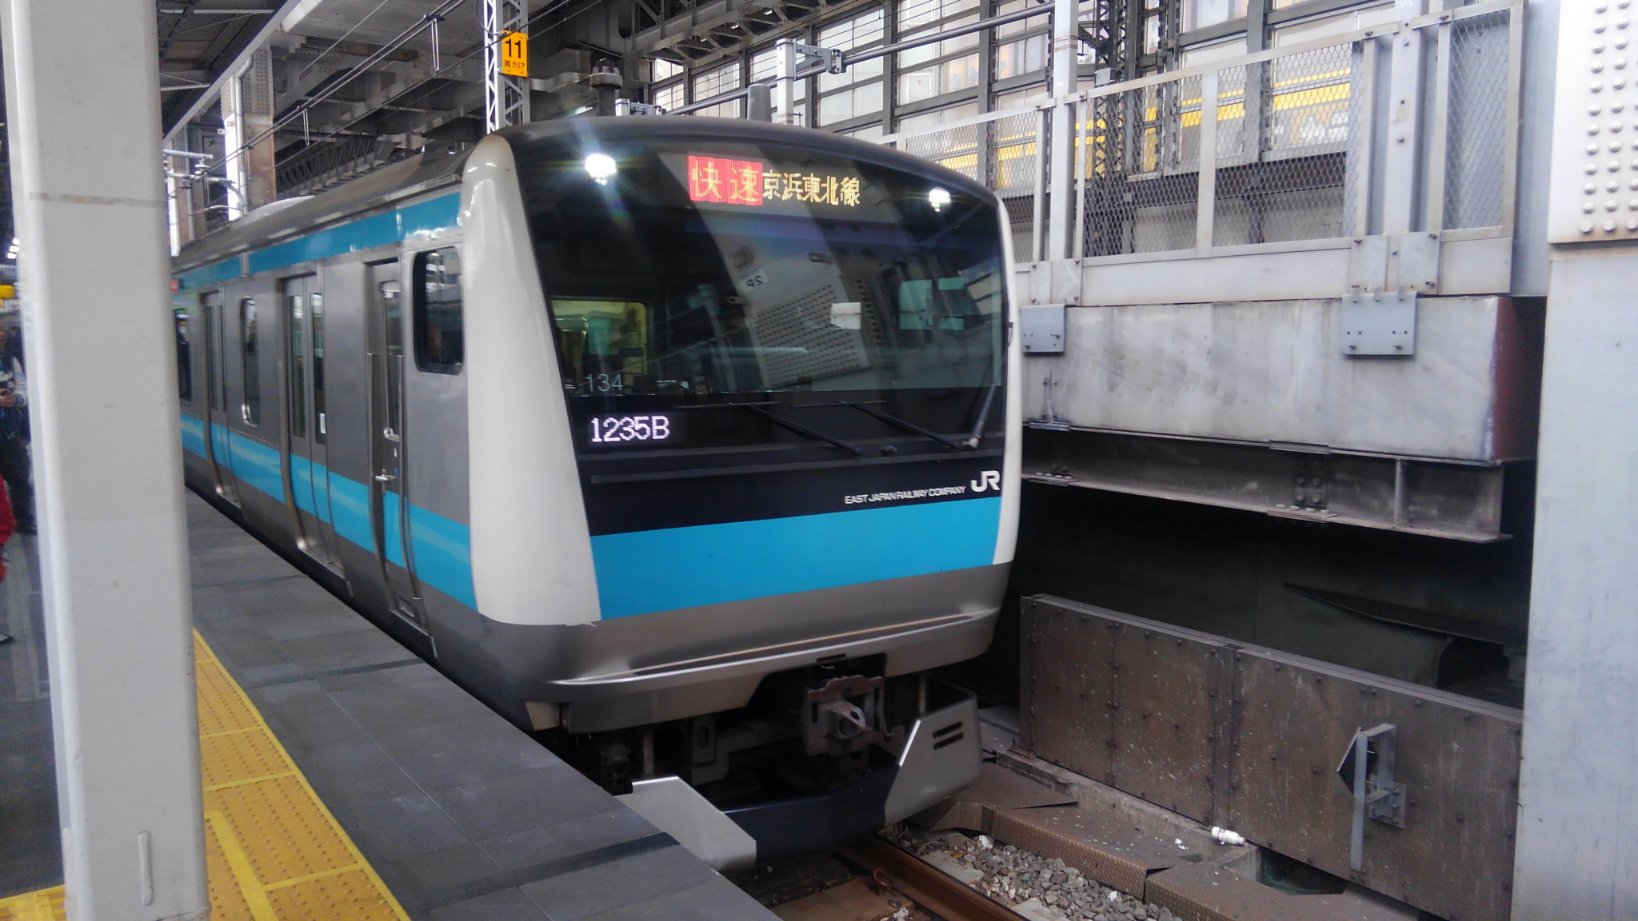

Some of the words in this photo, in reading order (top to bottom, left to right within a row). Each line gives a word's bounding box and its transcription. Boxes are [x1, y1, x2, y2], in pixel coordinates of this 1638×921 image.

[505, 39, 521, 58] 11
[691, 160, 759, 202] 快速
[762, 169, 861, 206] 京浜東北線
[585, 373, 624, 392] 134
[591, 415, 670, 442] 1235B
[970, 470, 1000, 493] JR
[844, 494, 868, 504] EAST
[869, 492, 897, 502] JAPAN
[897, 489, 928, 500] RAILWAY
[928, 486, 966, 497] COMPANY
